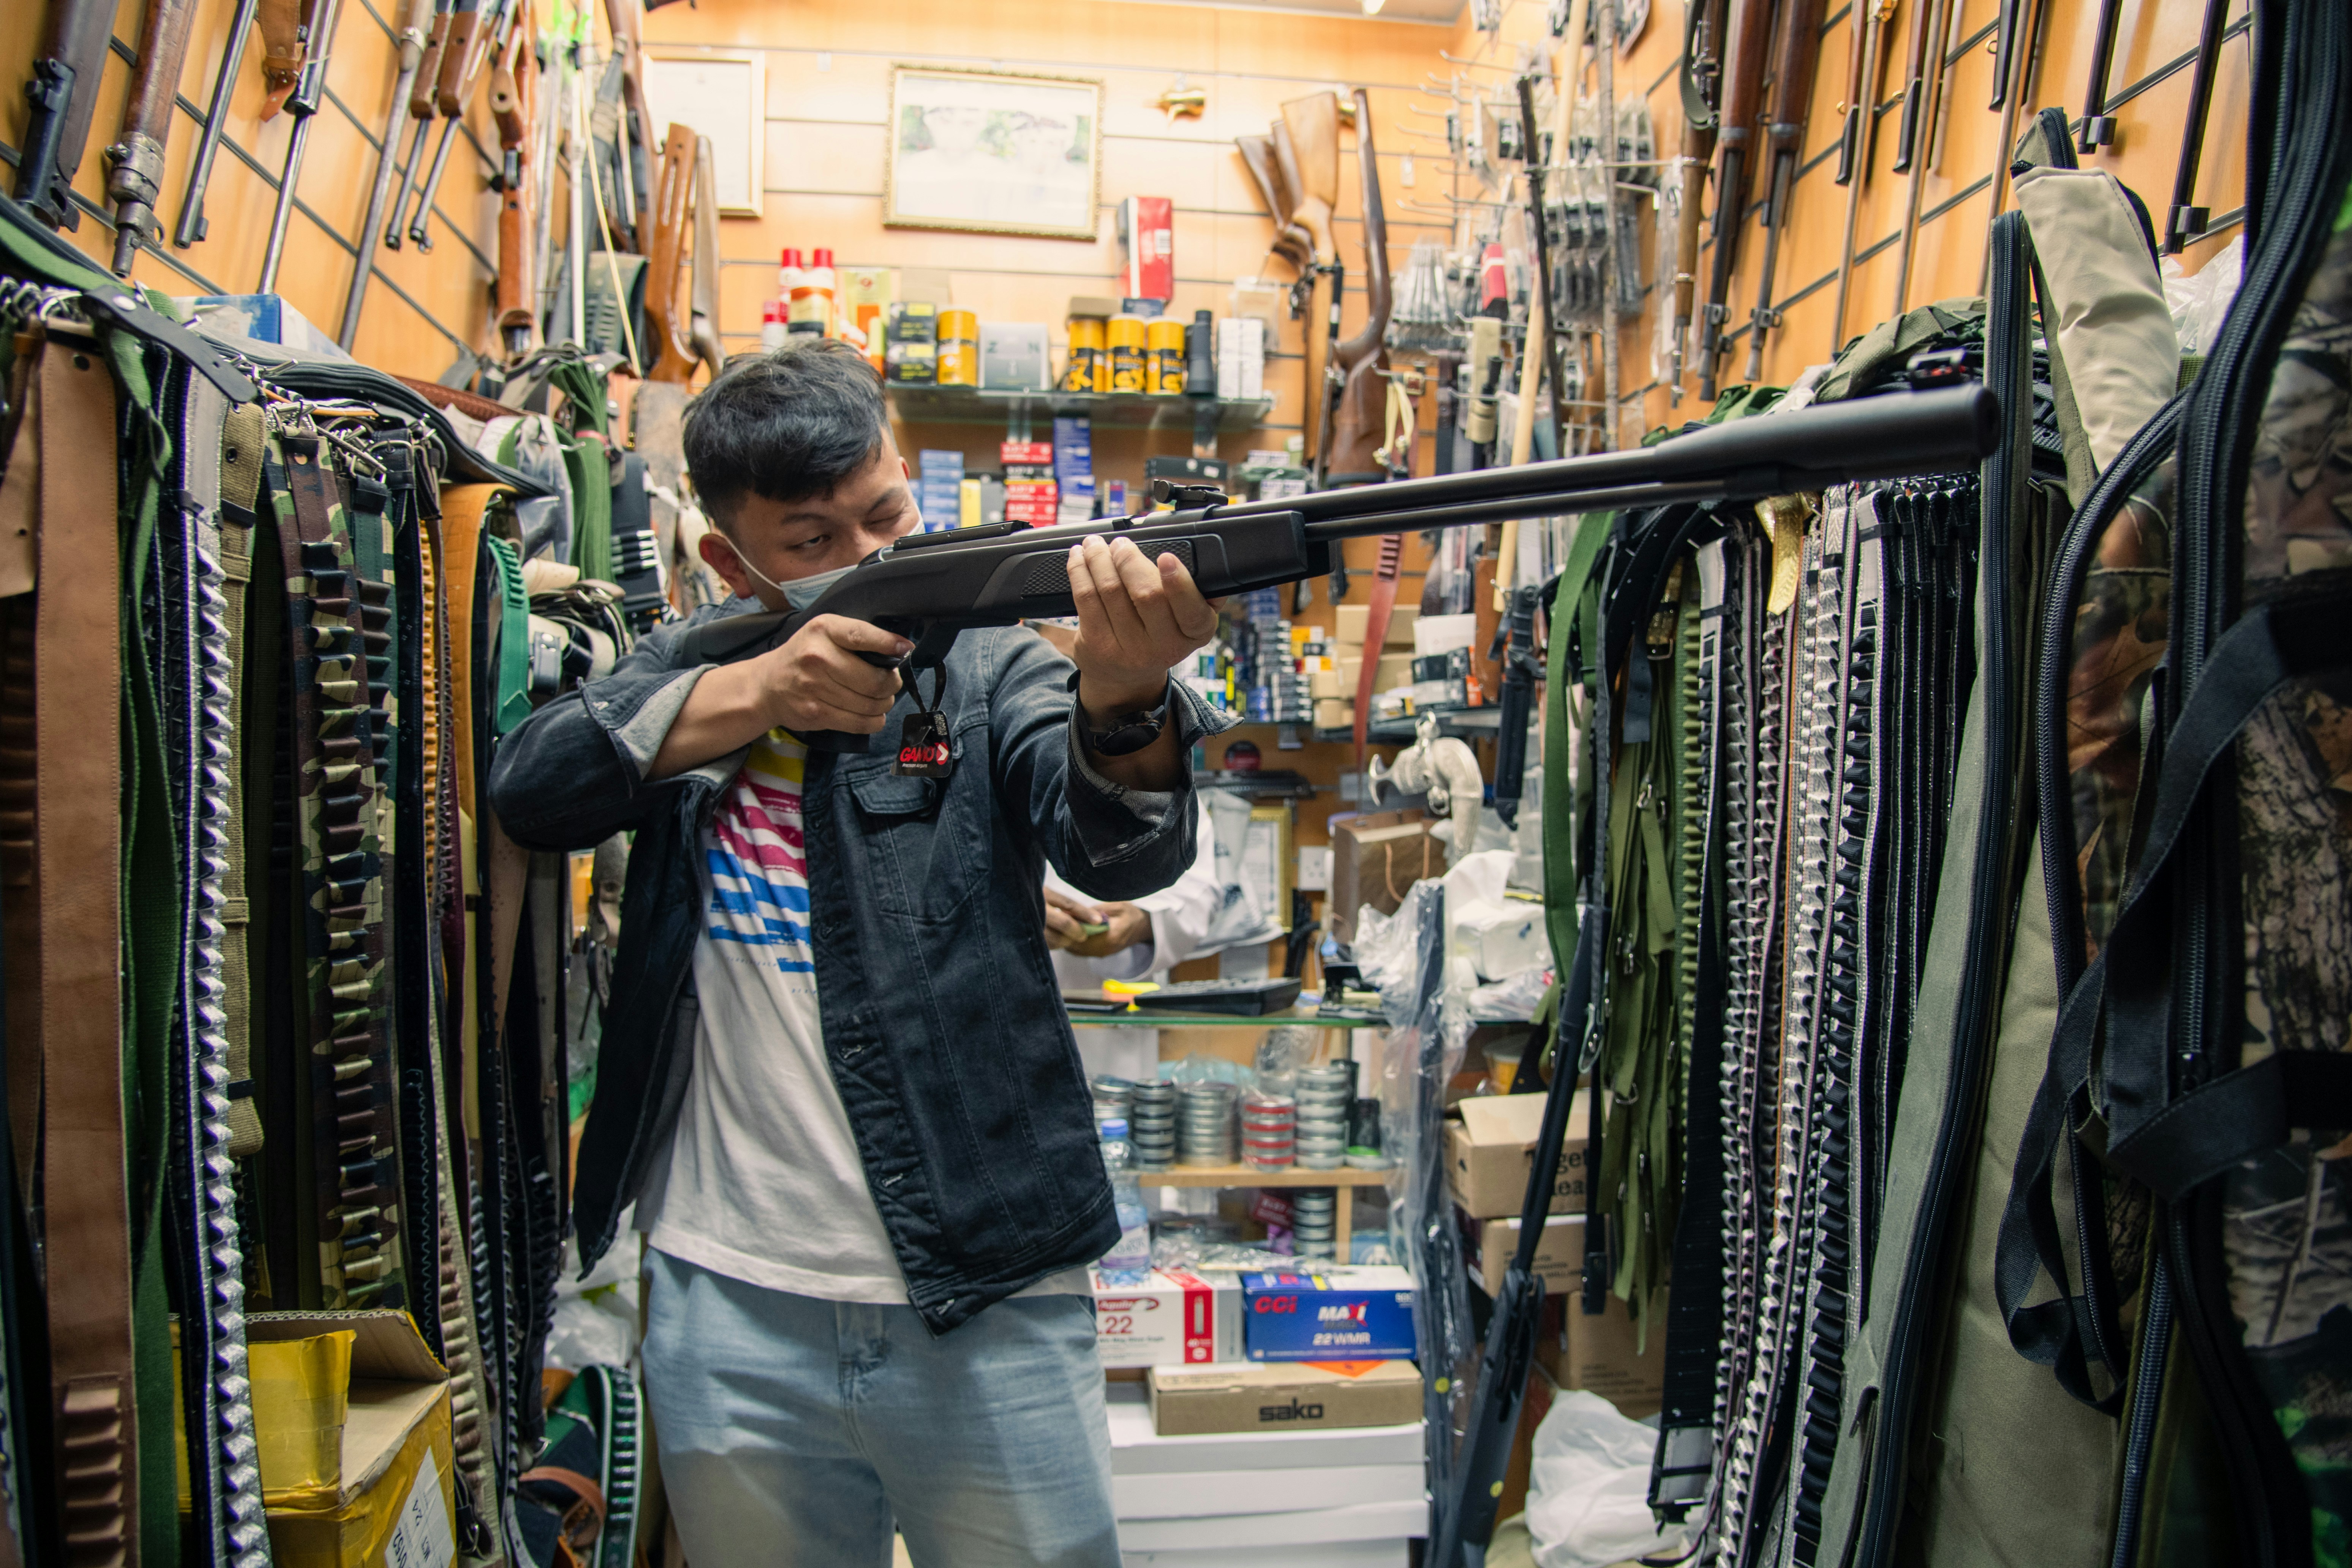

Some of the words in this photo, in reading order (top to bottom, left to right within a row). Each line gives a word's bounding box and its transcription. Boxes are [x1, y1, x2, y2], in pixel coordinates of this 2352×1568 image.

[900, 746, 934, 762] GAMO
[1318, 1301, 1369, 1325] MAXI
[1312, 1332, 1332, 1345] 22
[1333, 1332, 1371, 1345] WMR
[1260, 1397, 1323, 1421] sako
